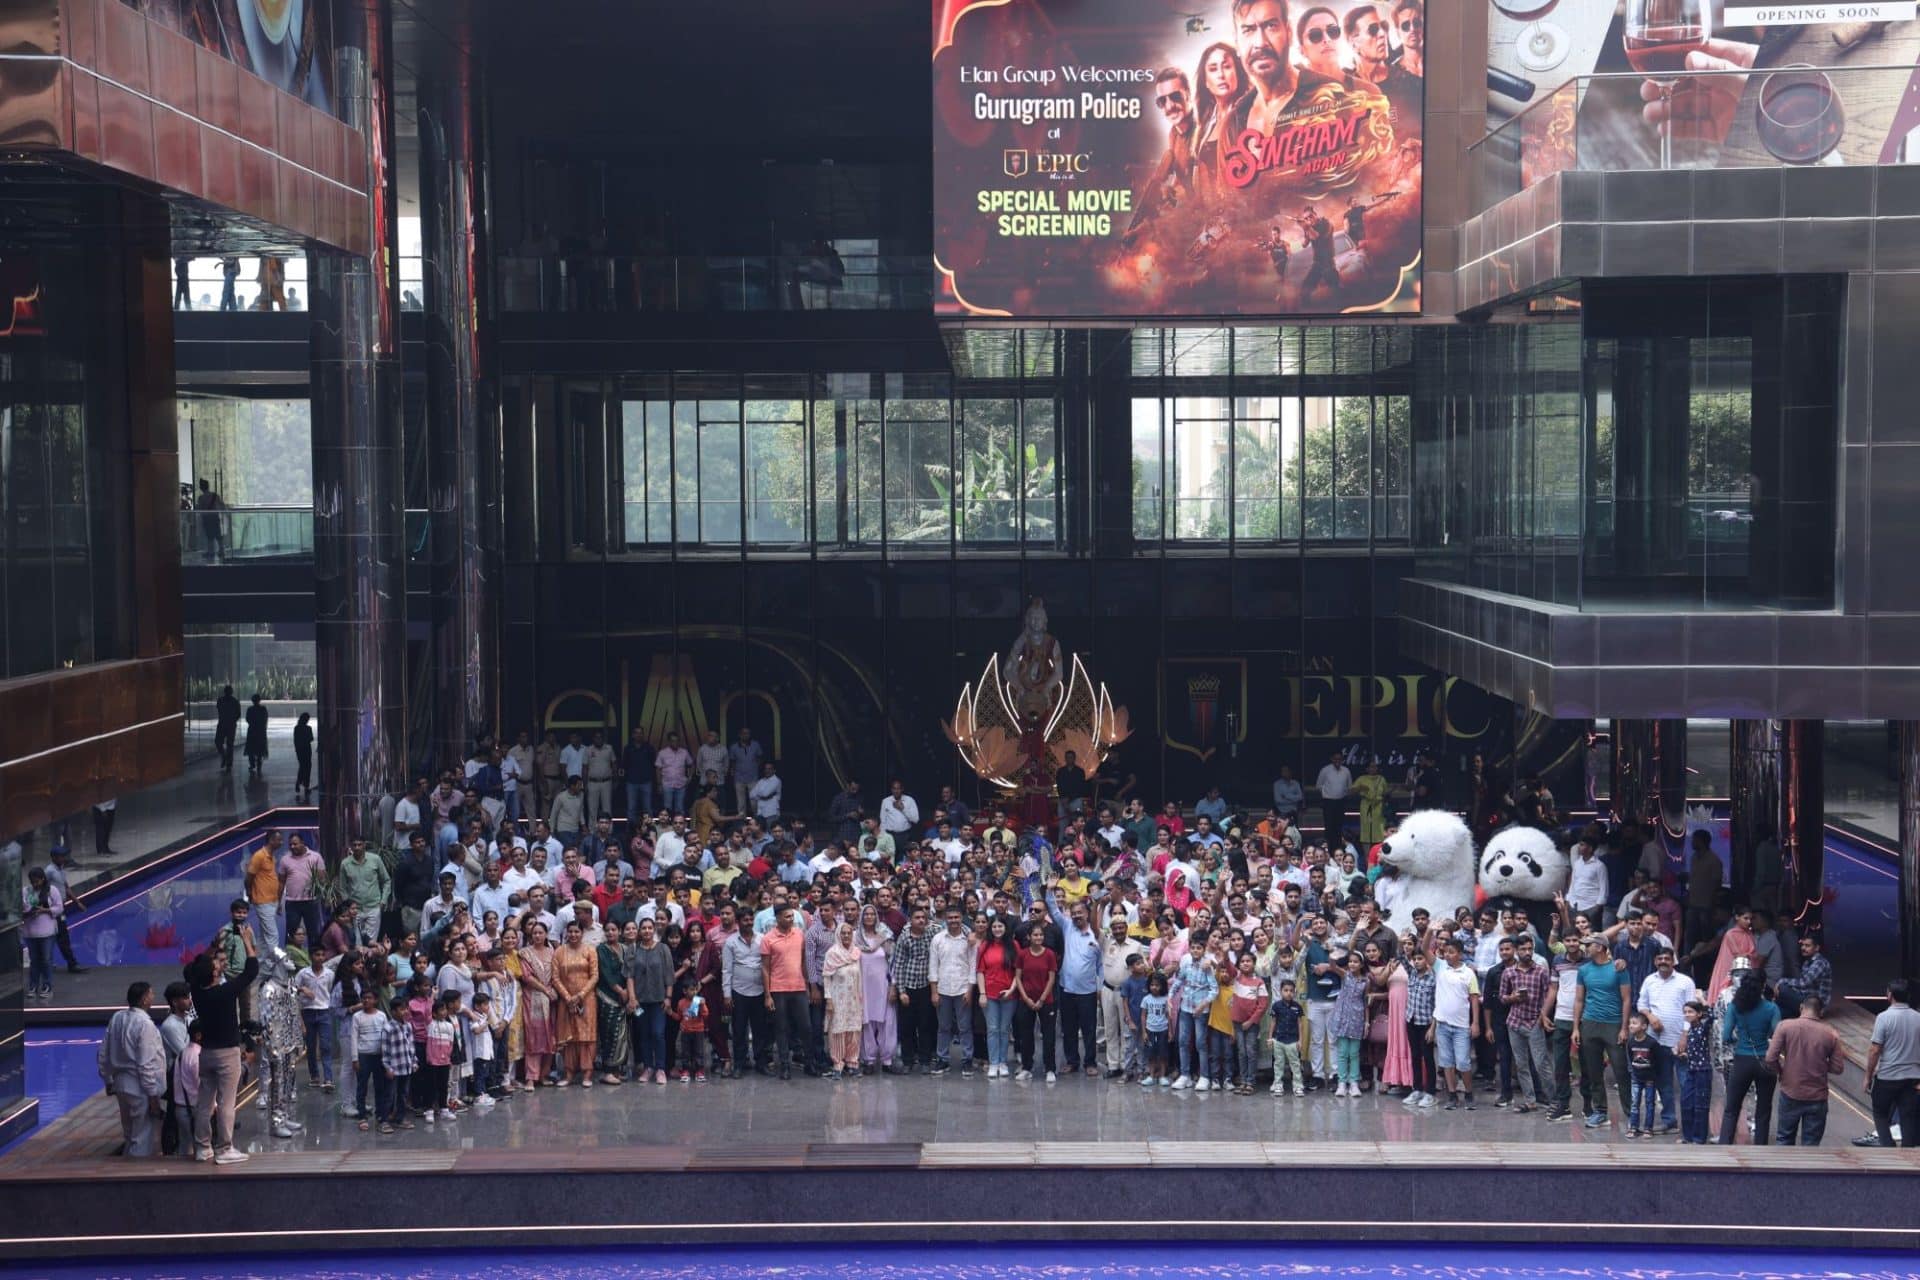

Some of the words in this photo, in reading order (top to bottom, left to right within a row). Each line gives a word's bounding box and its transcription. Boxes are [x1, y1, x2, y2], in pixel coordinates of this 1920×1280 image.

[1756, 7, 1827, 21] OPENING
[1838, 6, 1881, 19] SOON
[960, 66, 998, 83] Elan
[1003, 66, 1056, 88] Group
[1061, 65, 1155, 83] Welcomes
[975, 93, 1075, 124] Gurugram
[1081, 93, 1141, 119] Police
[1047, 128, 1061, 139] at
[1226, 110, 1371, 187] SINGHAM
[1036, 153, 1090, 173] EPIC
[1303, 151, 1346, 176] AGAIN
[977, 191, 1060, 212] SPECIAL
[1068, 190, 1132, 212] MOVIE
[998, 214, 1111, 236] SCREENING
[1280, 674, 1492, 739] EPIC
